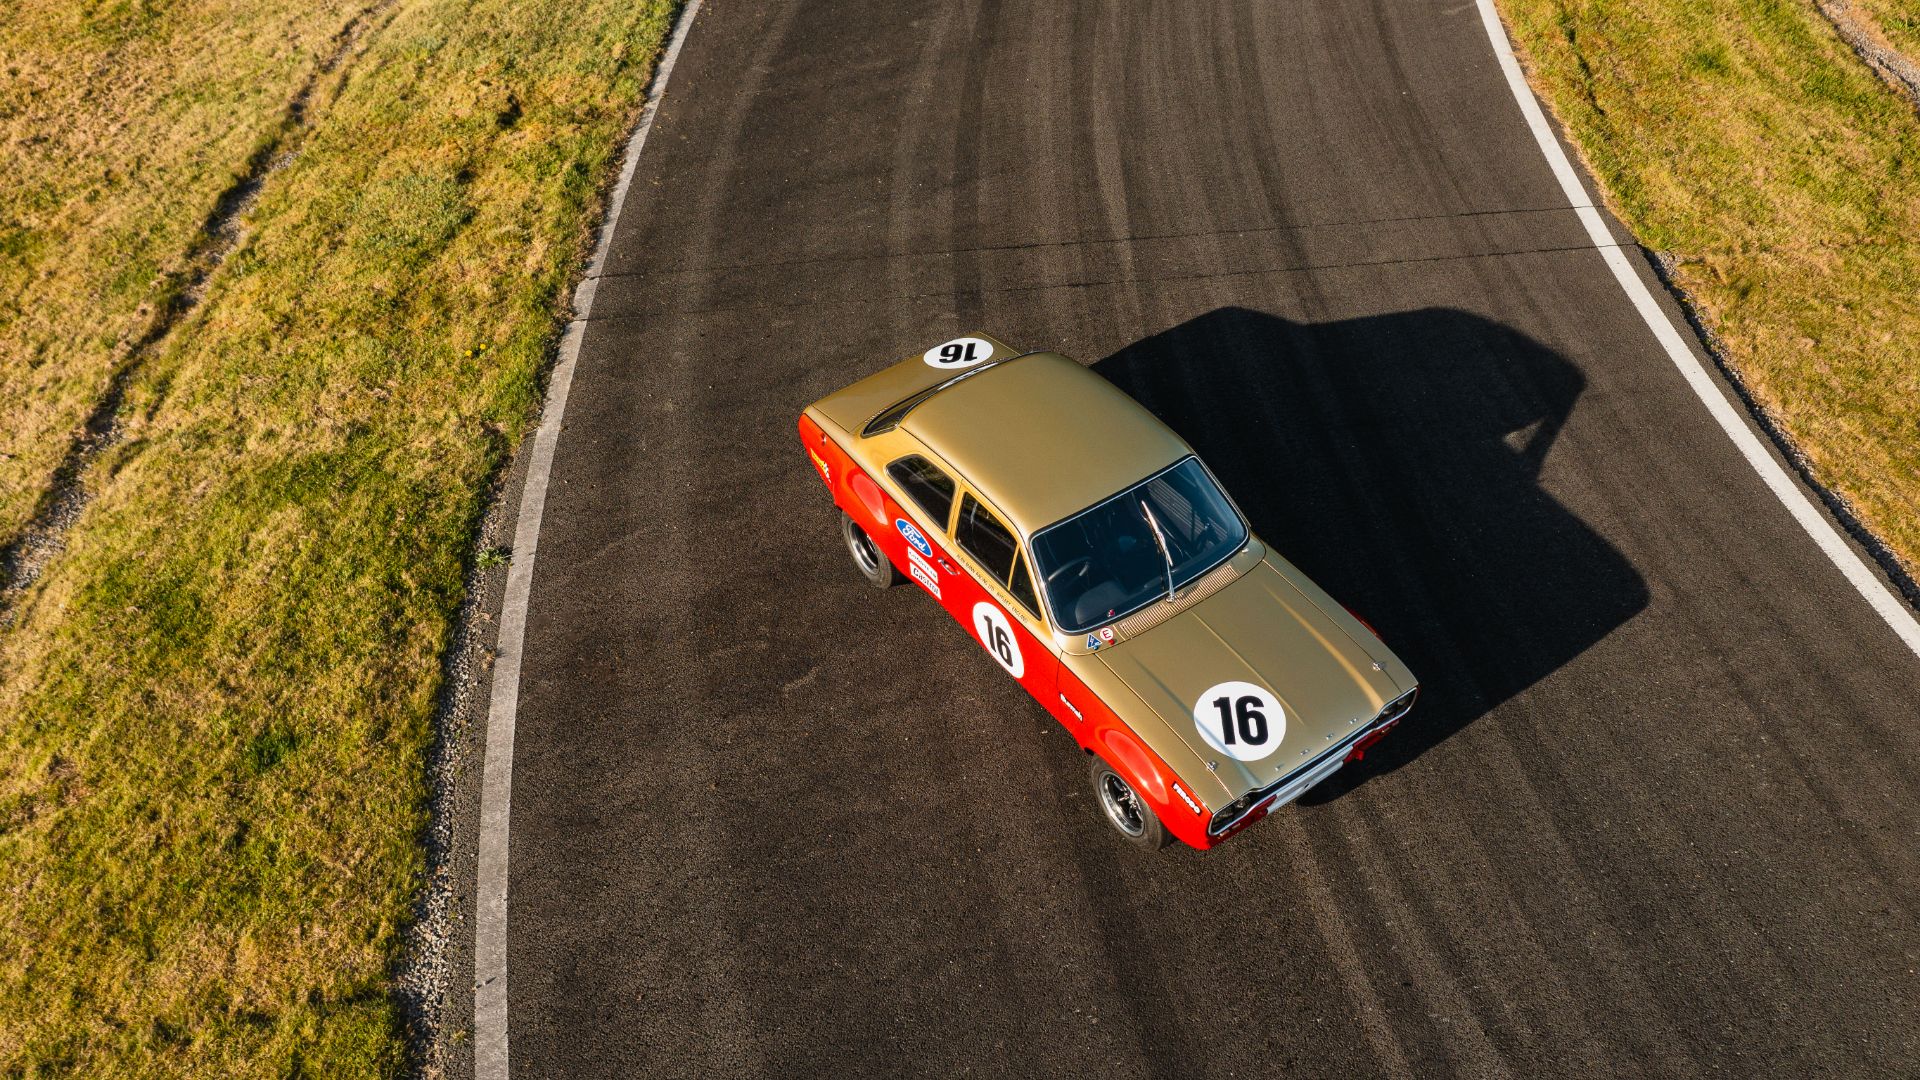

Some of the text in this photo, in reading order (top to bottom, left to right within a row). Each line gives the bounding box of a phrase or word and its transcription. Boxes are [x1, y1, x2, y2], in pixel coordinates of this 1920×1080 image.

[939, 343, 978, 363] 16
[902, 524, 926, 551] Ford
[913, 567, 939, 594] Castrol
[983, 615, 1013, 667] 16
[1213, 695, 1268, 745] 16
